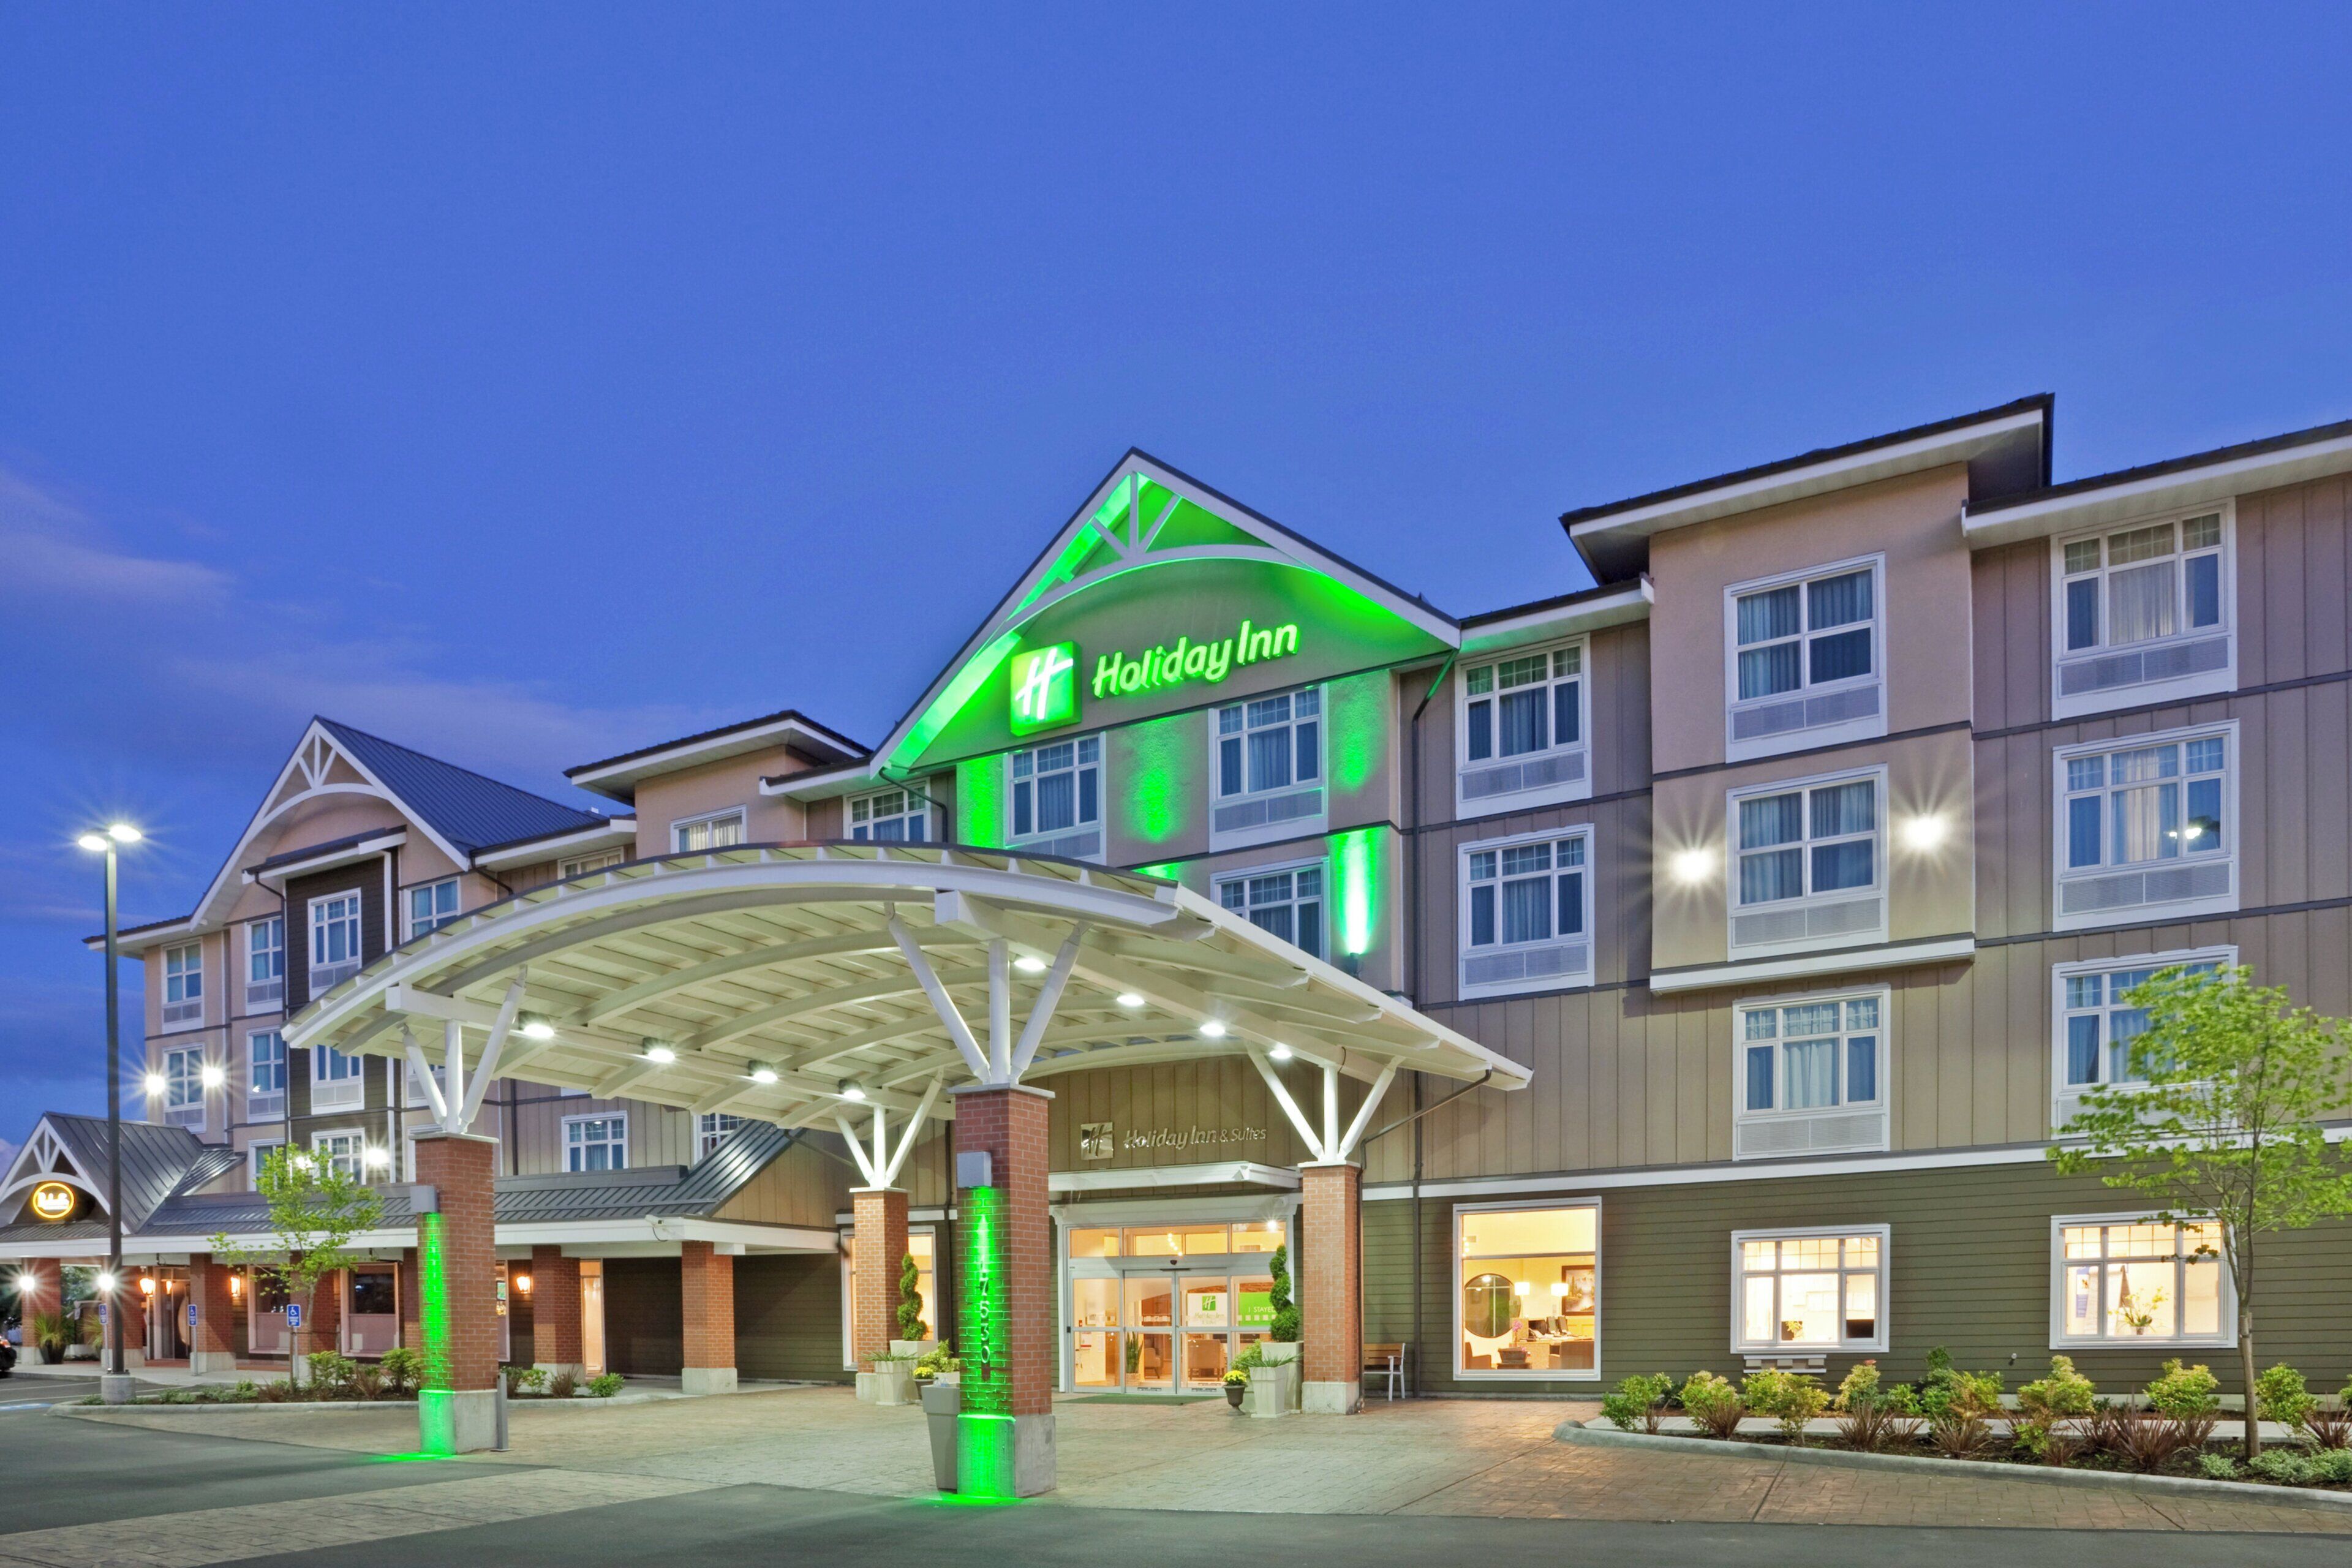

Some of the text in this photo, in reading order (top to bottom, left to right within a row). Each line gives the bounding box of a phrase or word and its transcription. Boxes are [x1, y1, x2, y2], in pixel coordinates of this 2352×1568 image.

[1093, 620, 1298, 698] Holiday Inn
[1123, 1125, 1267, 1150] Holiday Inn & Suites
